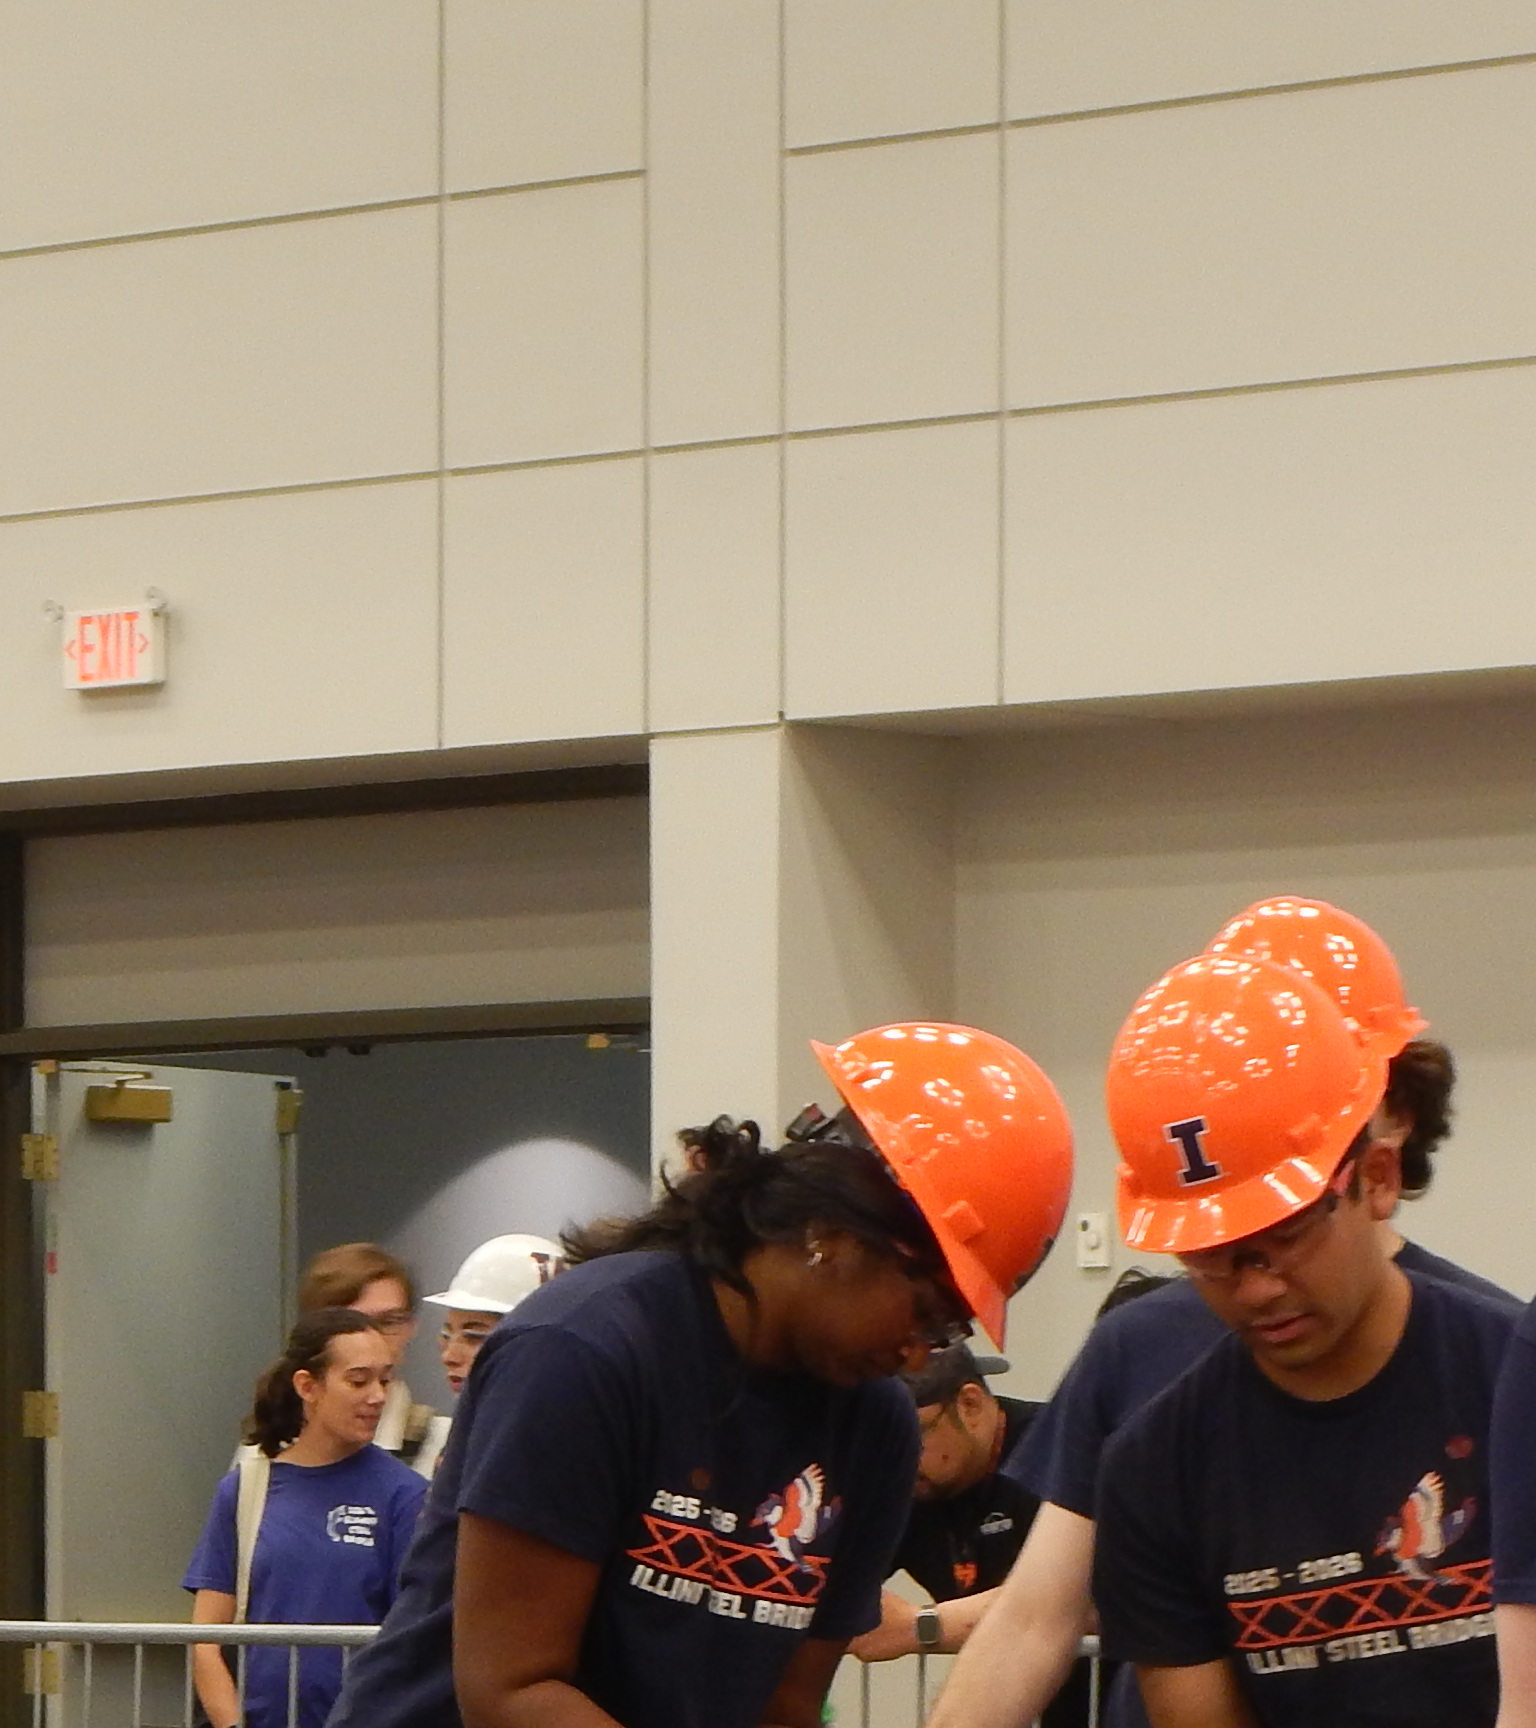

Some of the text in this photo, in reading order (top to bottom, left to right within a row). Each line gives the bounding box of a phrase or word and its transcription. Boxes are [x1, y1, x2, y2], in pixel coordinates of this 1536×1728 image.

[78, 611, 139, 682] EXIT
[1162, 1115, 1224, 1187] I
[1325, 1629, 1408, 1663] STEEL
